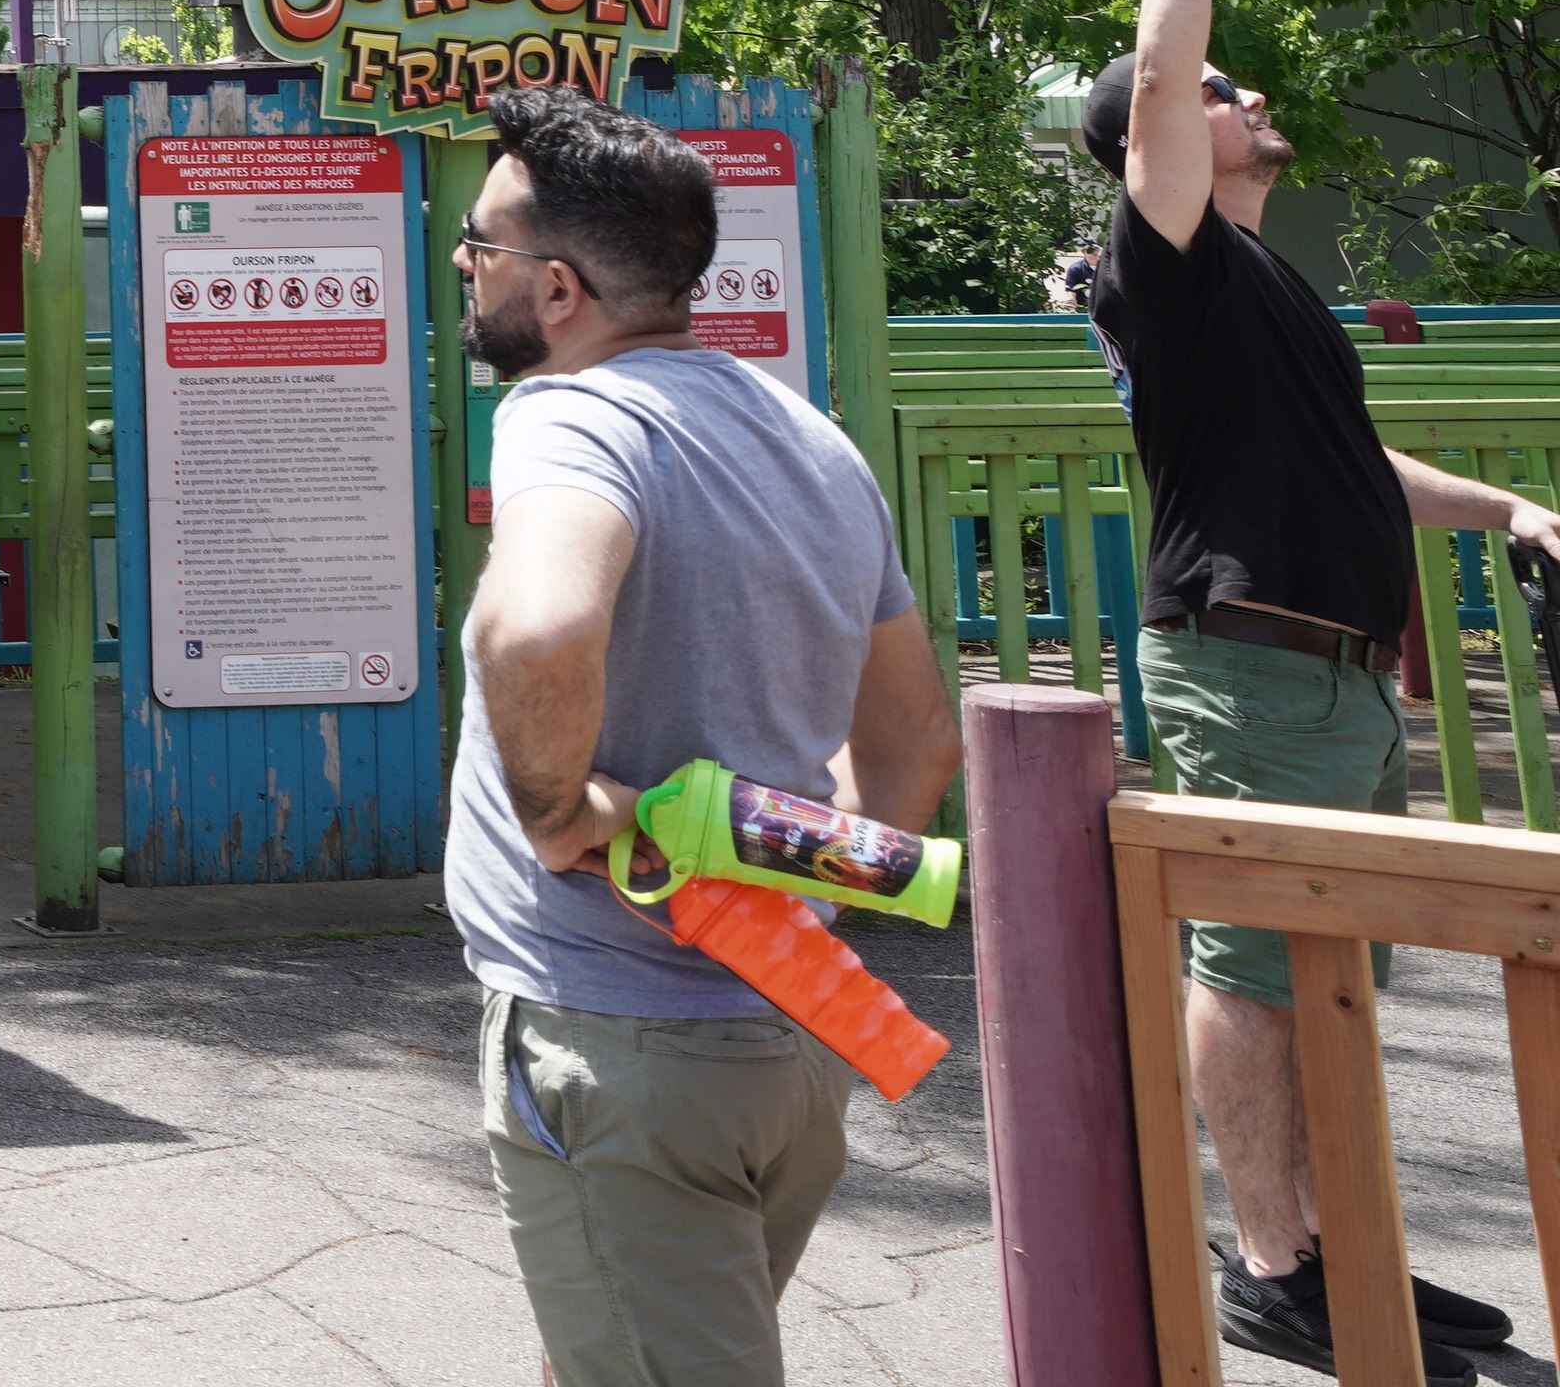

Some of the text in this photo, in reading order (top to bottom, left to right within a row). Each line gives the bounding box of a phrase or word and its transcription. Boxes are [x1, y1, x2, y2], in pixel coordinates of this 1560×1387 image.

[343, 27, 620, 112] FRIPON
[162, 140, 189, 149] NOTE
[191, 138, 198, 149] À
[201, 139, 265, 149] L'INTENTION
[267, 139, 280, 148] DE
[283, 139, 310, 148] TOUS
[312, 138, 330, 148] LES
[332, 136, 371, 147] INVITÉS
[690, 141, 727, 150] GUESTS
[162, 151, 378, 165] VEUILLEZ LIRE LES CONSIGNES DE SÉCURITÉ
[180, 165, 361, 176] IMPORTANTES CI-DESSOUS ET SUIVRE
[718, 167, 780, 176] ATTENDANTS
[188, 176, 354, 189] LES INSTRUCTIONS DES PRÉPOSÉS
[233, 254, 315, 266] OURSON FRIPON
[231, 376, 282, 385] APPLICABLES
